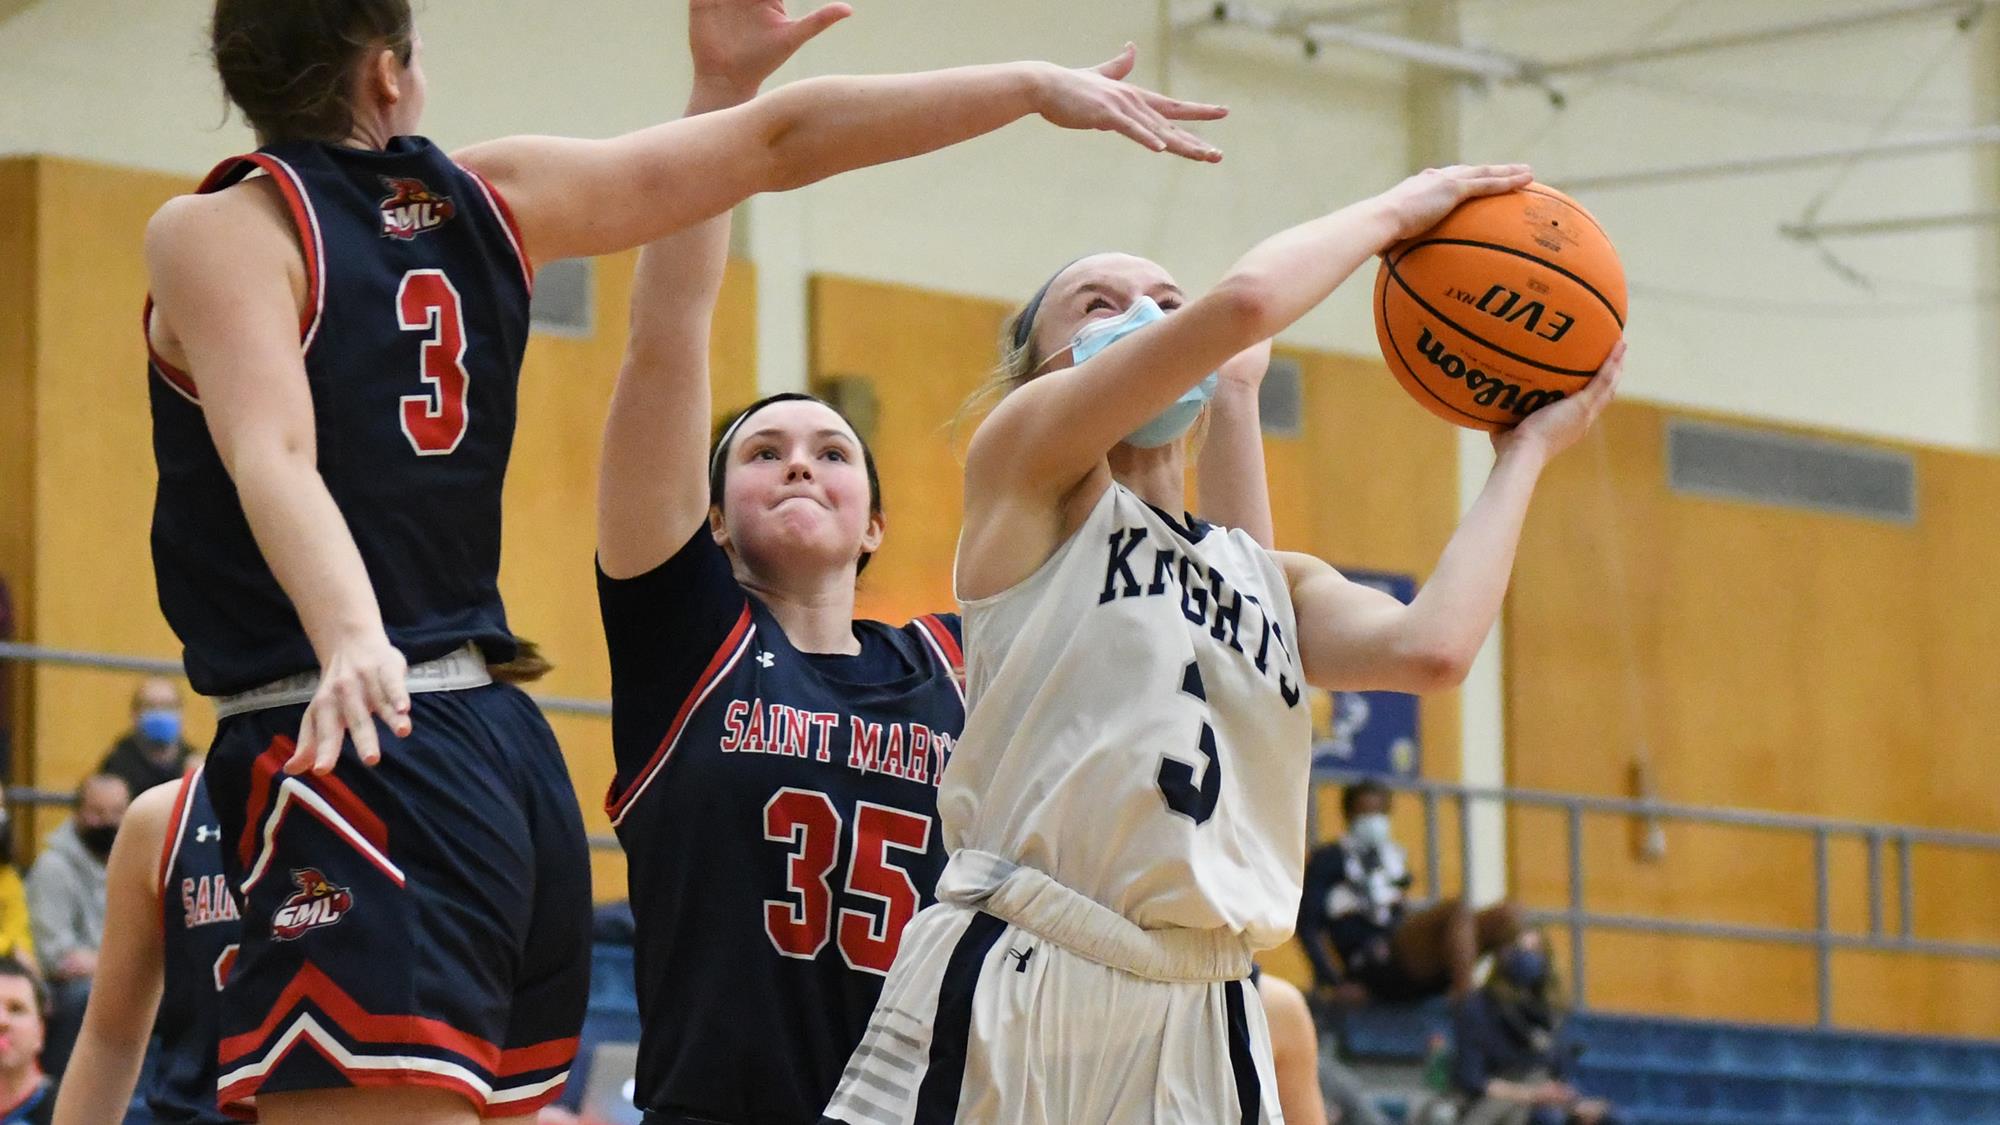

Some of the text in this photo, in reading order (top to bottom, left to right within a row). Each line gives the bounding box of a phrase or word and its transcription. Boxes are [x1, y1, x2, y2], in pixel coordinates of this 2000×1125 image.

[396, 269, 470, 456] 3
[1474, 284, 1576, 343] EVO
[1099, 527, 1301, 709] KNGHTS
[720, 697, 840, 763] SAINT
[1153, 659, 1222, 828] 3
[763, 786, 932, 977] 35
